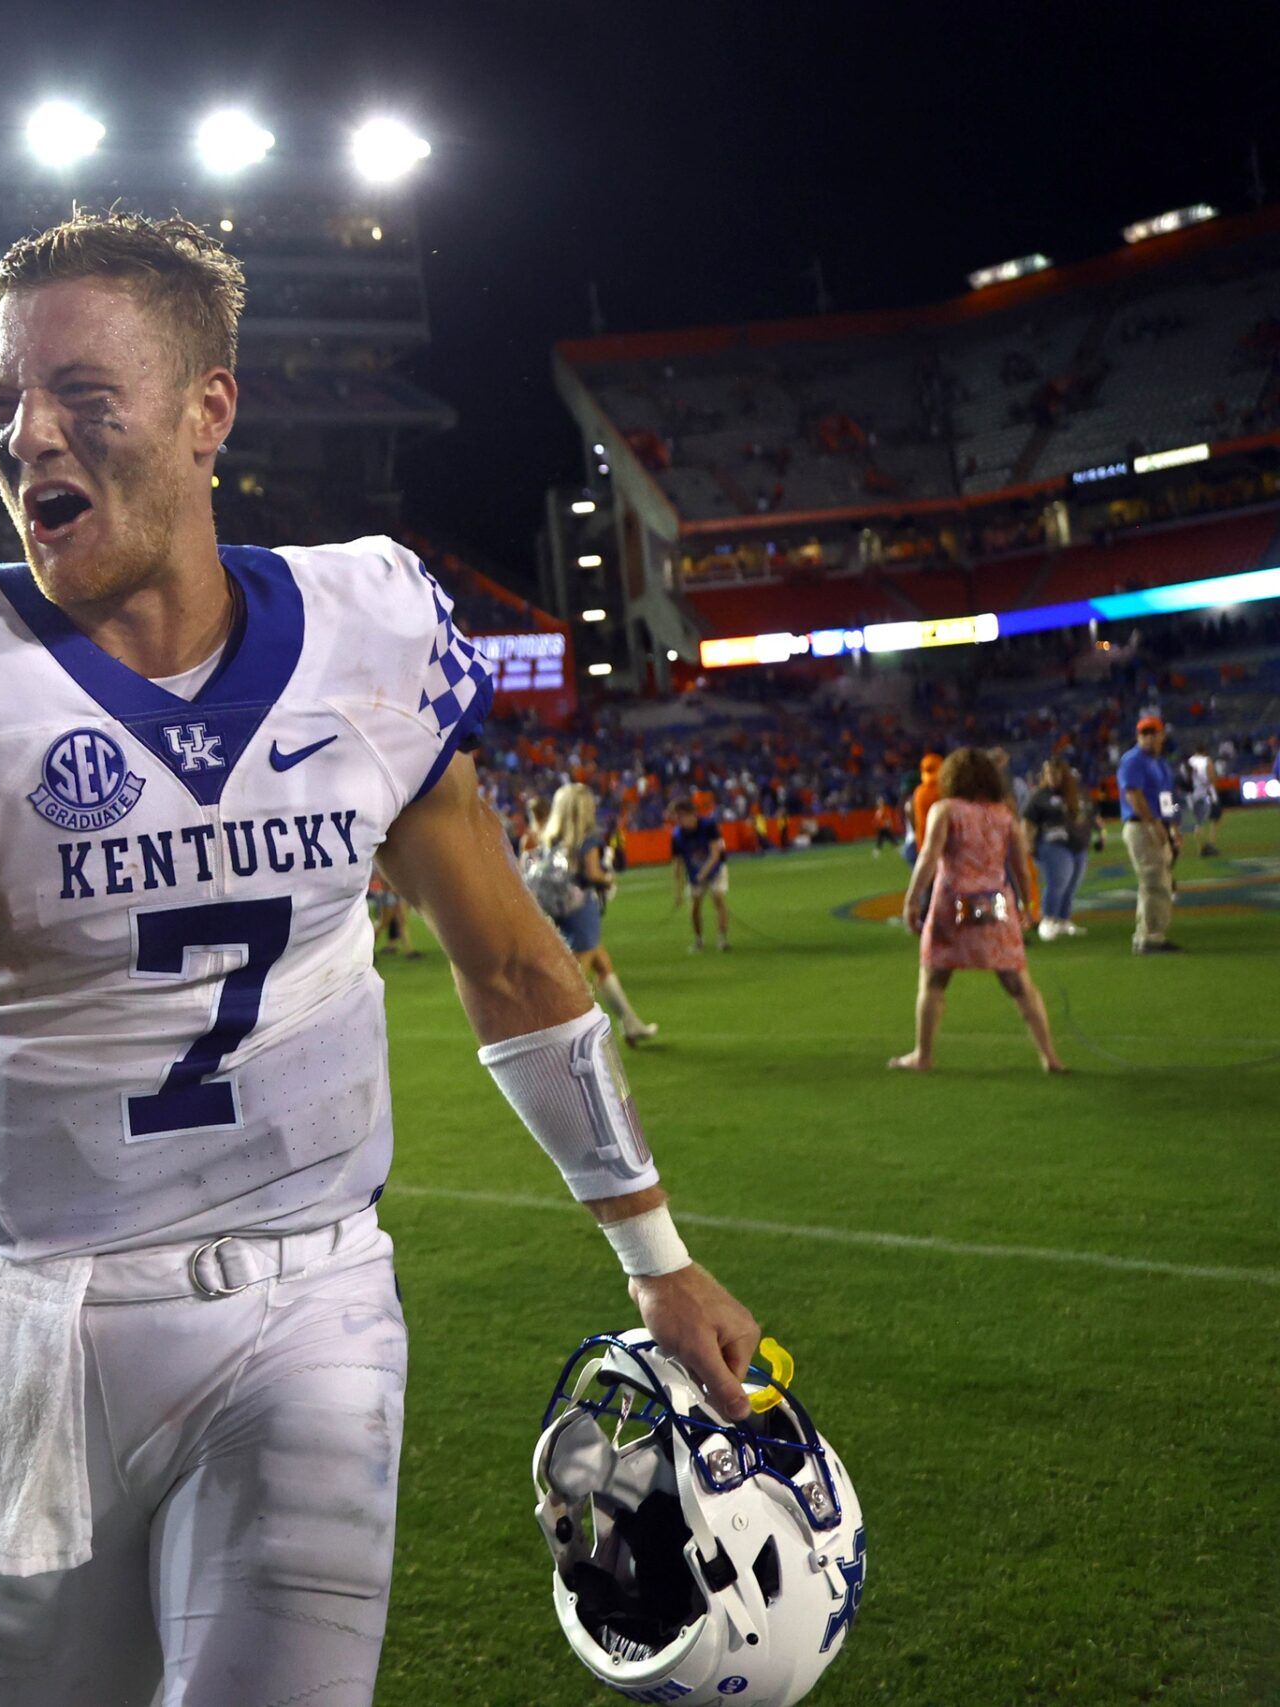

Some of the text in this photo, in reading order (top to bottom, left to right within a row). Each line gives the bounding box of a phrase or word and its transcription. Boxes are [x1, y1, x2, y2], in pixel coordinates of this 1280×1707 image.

[50, 734, 119, 804] SEC
[163, 722, 225, 772] UK
[44, 793, 134, 829] GRADUATE
[57, 809, 358, 899] KENTUCKY
[122, 894, 293, 1144] 7
